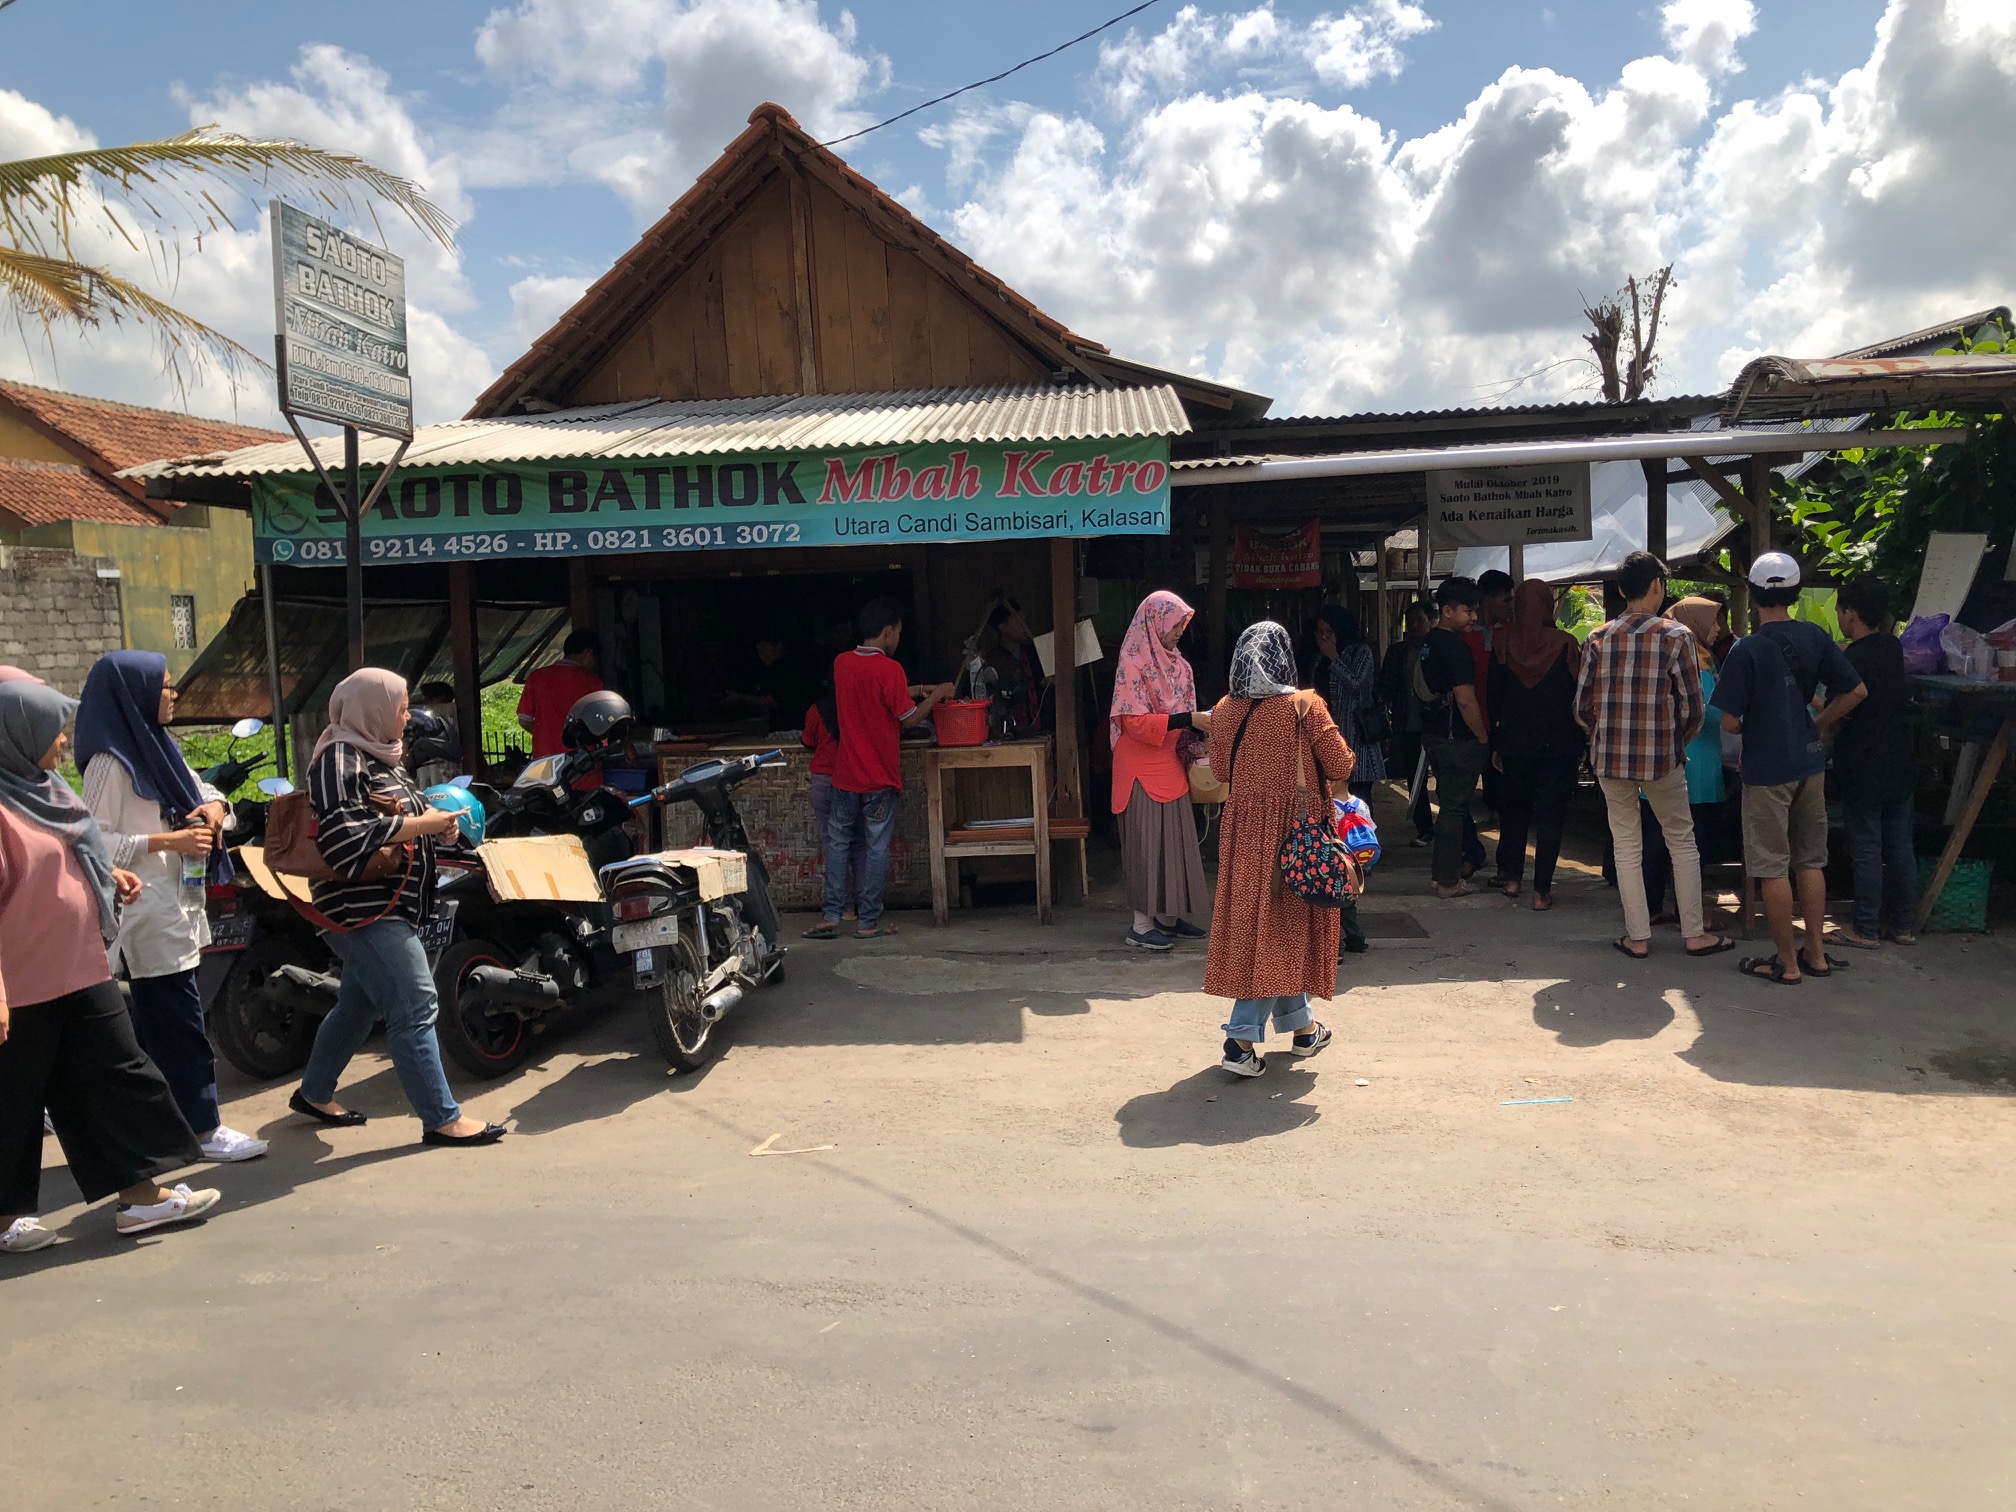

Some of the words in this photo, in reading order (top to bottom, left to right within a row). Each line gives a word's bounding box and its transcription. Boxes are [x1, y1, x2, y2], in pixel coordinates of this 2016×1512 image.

[306, 223, 386, 287] SAOTO
[298, 260, 397, 330] BATHOK
[291, 302, 350, 351] Mbah
[355, 329, 406, 369] Katro
[292, 344, 317, 367] BUKA
[322, 355, 340, 377] Jam
[340, 361, 364, 385] 06.00
[369, 371, 390, 393] 16.00
[390, 378, 407, 397] WIB
[548, 460, 808, 515] BATHOK
[816, 449, 982, 505] Mbah
[995, 448, 1166, 499] Katro
[1440, 493, 1470, 503] Saoto
[1473, 491, 1511, 502] Bathok
[1514, 489, 1542, 500] Mbah
[1545, 488, 1572, 498] Katro
[1454, 480, 1484, 489] Mulai
[1486, 478, 1528, 488] Oktober
[1531, 475, 1560, 486] 2019
[834, 516, 890, 536] Utara
[897, 512, 958, 534] Candi
[964, 510, 1074, 533] Sambisari,
[1081, 508, 1165, 528] Kalasan
[1440, 510, 1464, 522] Ada
[1468, 507, 1531, 521] Kenaikan
[1535, 505, 1574, 519] Harga
[300, 540, 348, 560] 081
[369, 537, 436, 559] 9214
[444, 534, 509, 556] 4526
[534, 532, 579, 552] HP.
[587, 529, 652, 550] 0821
[662, 526, 727, 548] 3601
[736, 523, 801, 544] 3072
[1526, 525, 1579, 535] Terimakasih.
[1235, 563, 1261, 573] TIDAK
[1263, 563, 1287, 574] BUKA
[1288, 561, 1320, 573] CABANG
